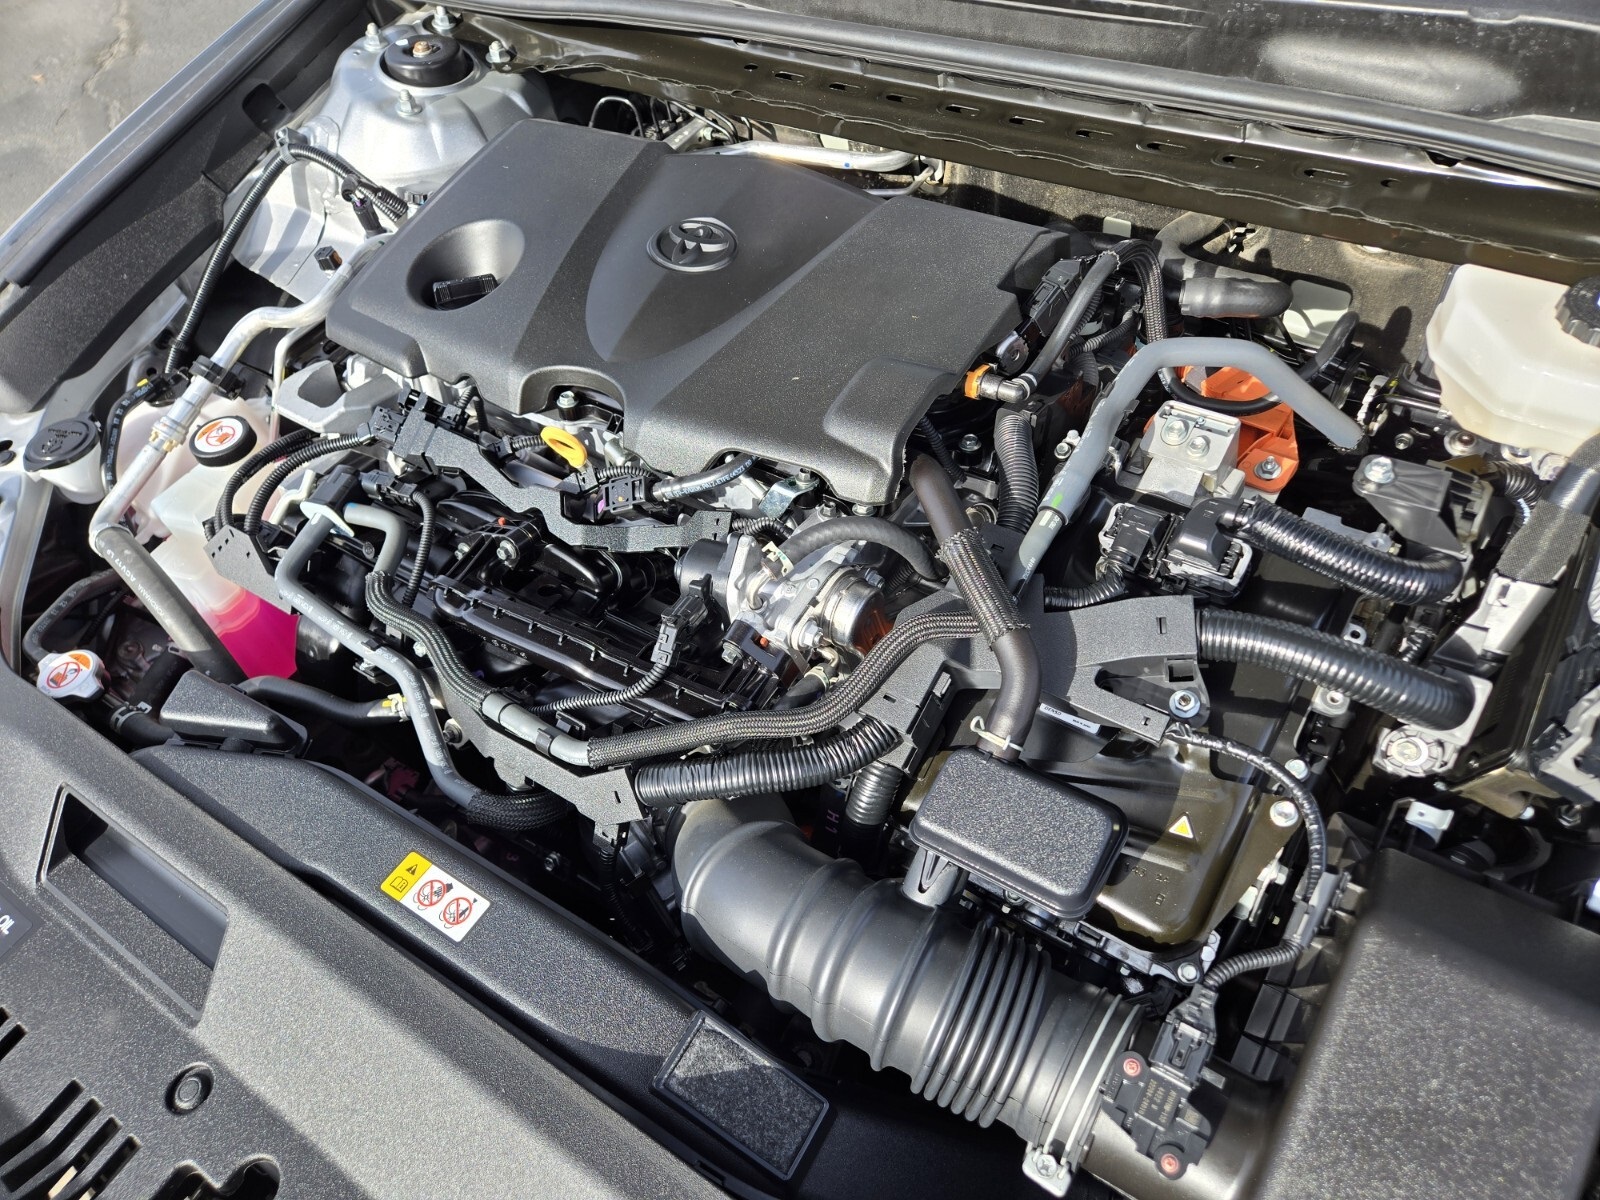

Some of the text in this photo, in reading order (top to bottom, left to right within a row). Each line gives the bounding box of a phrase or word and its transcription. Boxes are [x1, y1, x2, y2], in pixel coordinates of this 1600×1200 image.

[114, 558, 137, 583] ACV17
[137, 583, 165, 617] YOKOHAMA
[1044, 706, 1062, 716] DENSO
[0, 914, 15, 935] OIL
